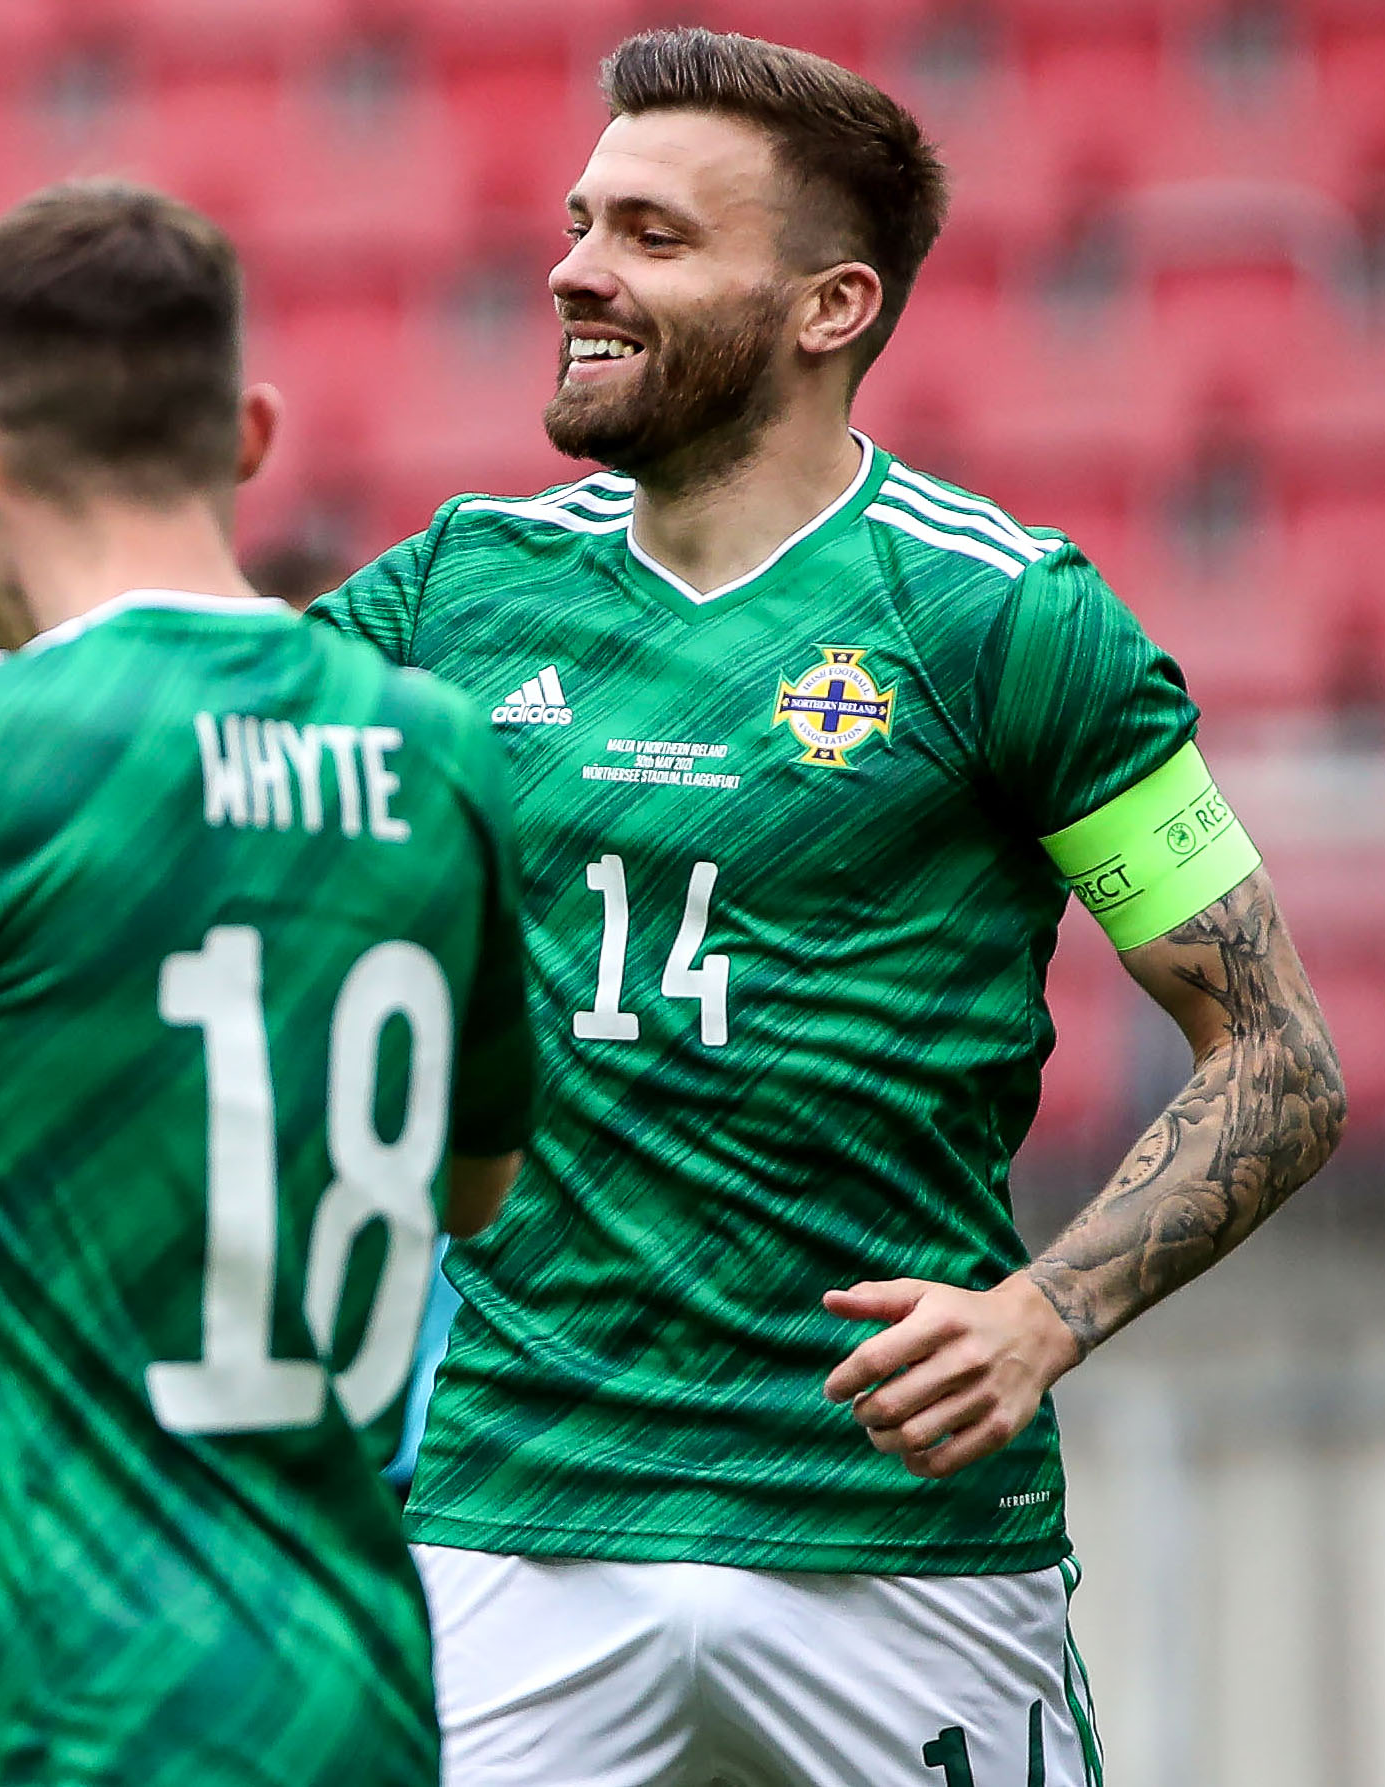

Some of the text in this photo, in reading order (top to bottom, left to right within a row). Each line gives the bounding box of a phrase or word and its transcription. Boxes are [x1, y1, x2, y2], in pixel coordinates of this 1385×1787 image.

[828, 667, 872, 697] FOOTBALL
[492, 702, 573, 725] adidas
[837, 701, 878, 715] IRELAND
[798, 721, 863, 745] ASSOCIATION
[606, 739, 637, 752] MALTA
[643, 741, 691, 756] NORTHERN
[690, 743, 729, 758] IRELAND
[654, 756, 675, 769] MAY
[673, 757, 695, 770] 2021
[194, 709, 412, 844] WHYTE
[682, 772, 741, 789] KLAGENFURT
[573, 854, 730, 1046] 14
[144, 924, 455, 1434] 18
